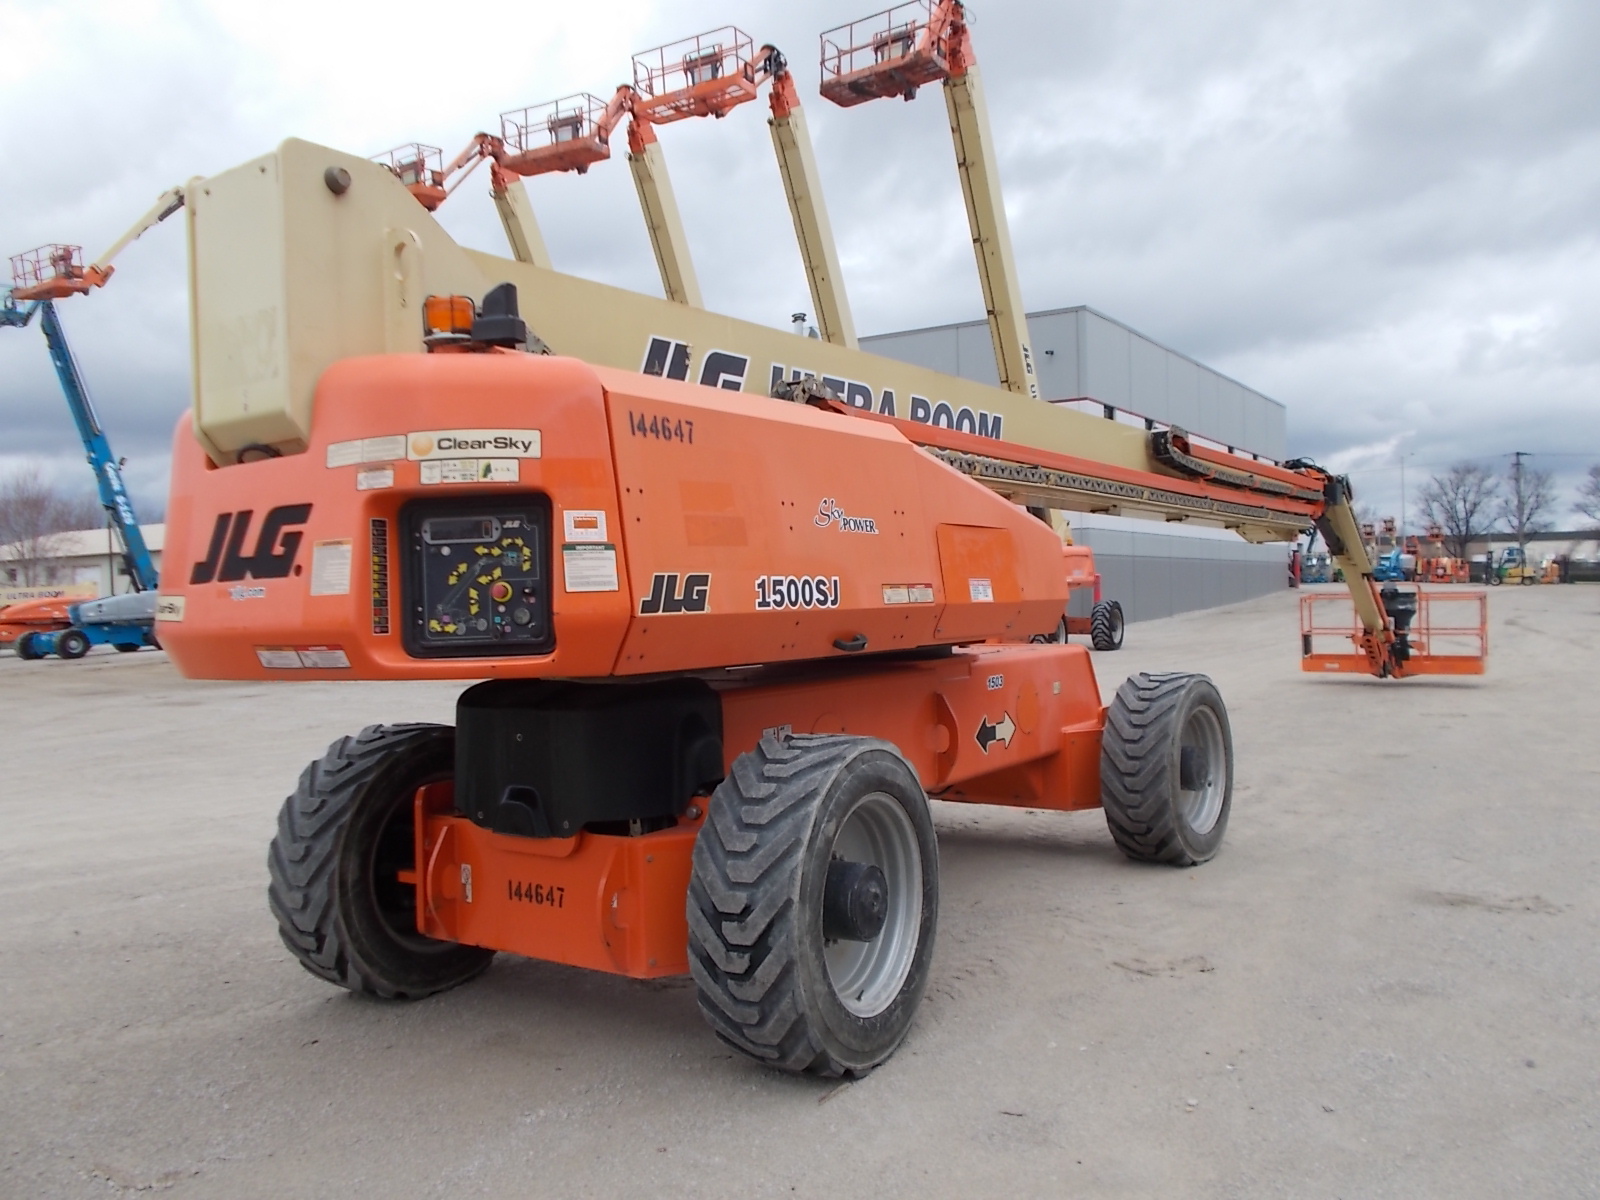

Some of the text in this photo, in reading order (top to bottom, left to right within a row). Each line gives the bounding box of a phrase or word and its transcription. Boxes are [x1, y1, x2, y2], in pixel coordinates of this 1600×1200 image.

[437, 436, 532, 453] ClearSky
[629, 410, 693, 444] 144647
[909, 394, 1003, 460] BOOM
[814, 498, 877, 534] Sky POWER
[190, 503, 313, 585] JLG
[639, 573, 712, 616] JLG
[756, 575, 840, 610] 1500SJ
[508, 880, 565, 908] 144647
